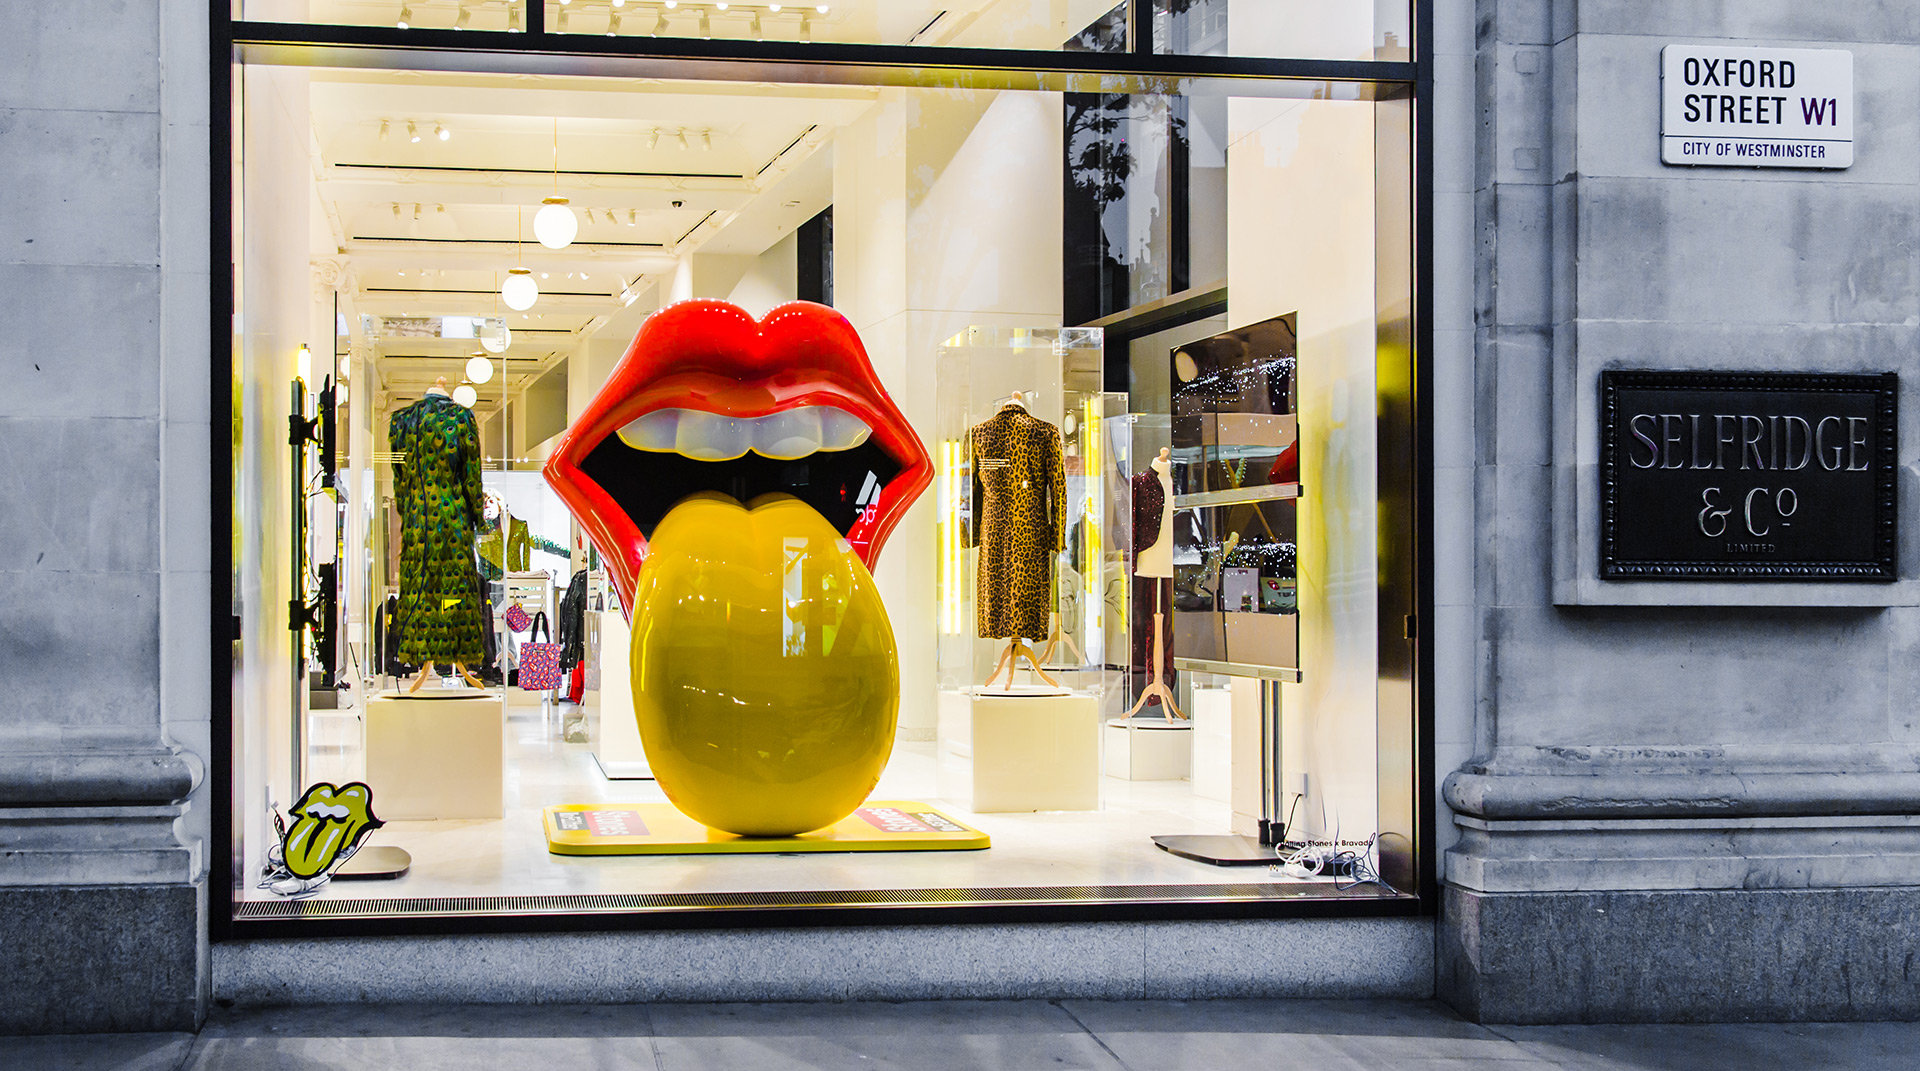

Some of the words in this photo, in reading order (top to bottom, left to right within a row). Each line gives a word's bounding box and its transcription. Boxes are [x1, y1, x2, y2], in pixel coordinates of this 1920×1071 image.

[1683, 57, 1796, 88] OXFORD
[1683, 94, 1787, 124] STREET
[1800, 97, 1837, 126] W1
[1683, 142, 1711, 155] CITY
[1716, 142, 1732, 156] OF
[1735, 143, 1826, 159] WESTMINSTER
[1629, 413, 1870, 471] SELFRIDGE
[1698, 487, 1732, 537] &
[1726, 543, 1776, 553] LIMITED
